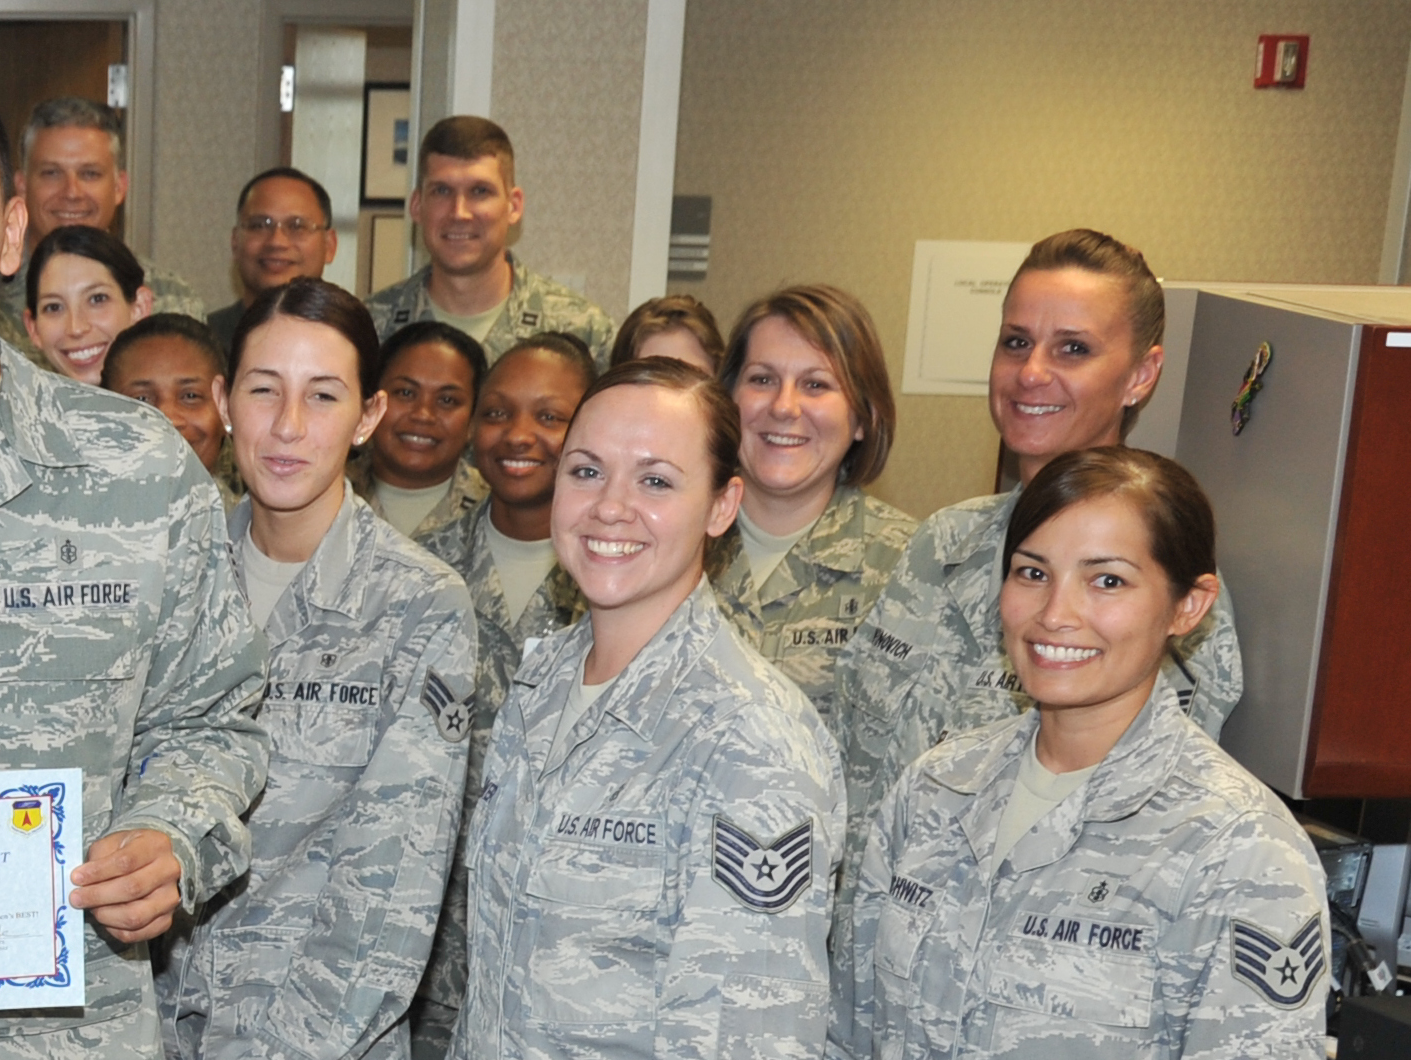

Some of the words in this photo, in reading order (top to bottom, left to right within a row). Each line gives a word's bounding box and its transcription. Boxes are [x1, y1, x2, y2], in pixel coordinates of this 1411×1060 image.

[3, 586, 36, 608] U.S.
[43, 585, 74, 607] AIR
[81, 583, 131, 605] FORCE
[793, 630, 819, 645] U.S.
[825, 628, 848, 644] AIR
[995, 671, 1018, 691] AIR
[262, 682, 287, 700] U.S.
[293, 682, 322, 701] AIR
[330, 683, 378, 705] FORCE
[557, 814, 580, 836] U.S.
[580, 817, 601, 838] AIR
[602, 819, 656, 844] FORCE
[1023, 915, 1048, 937] U.S.
[1052, 918, 1080, 943] AIR
[1088, 923, 1143, 951] FORCE
